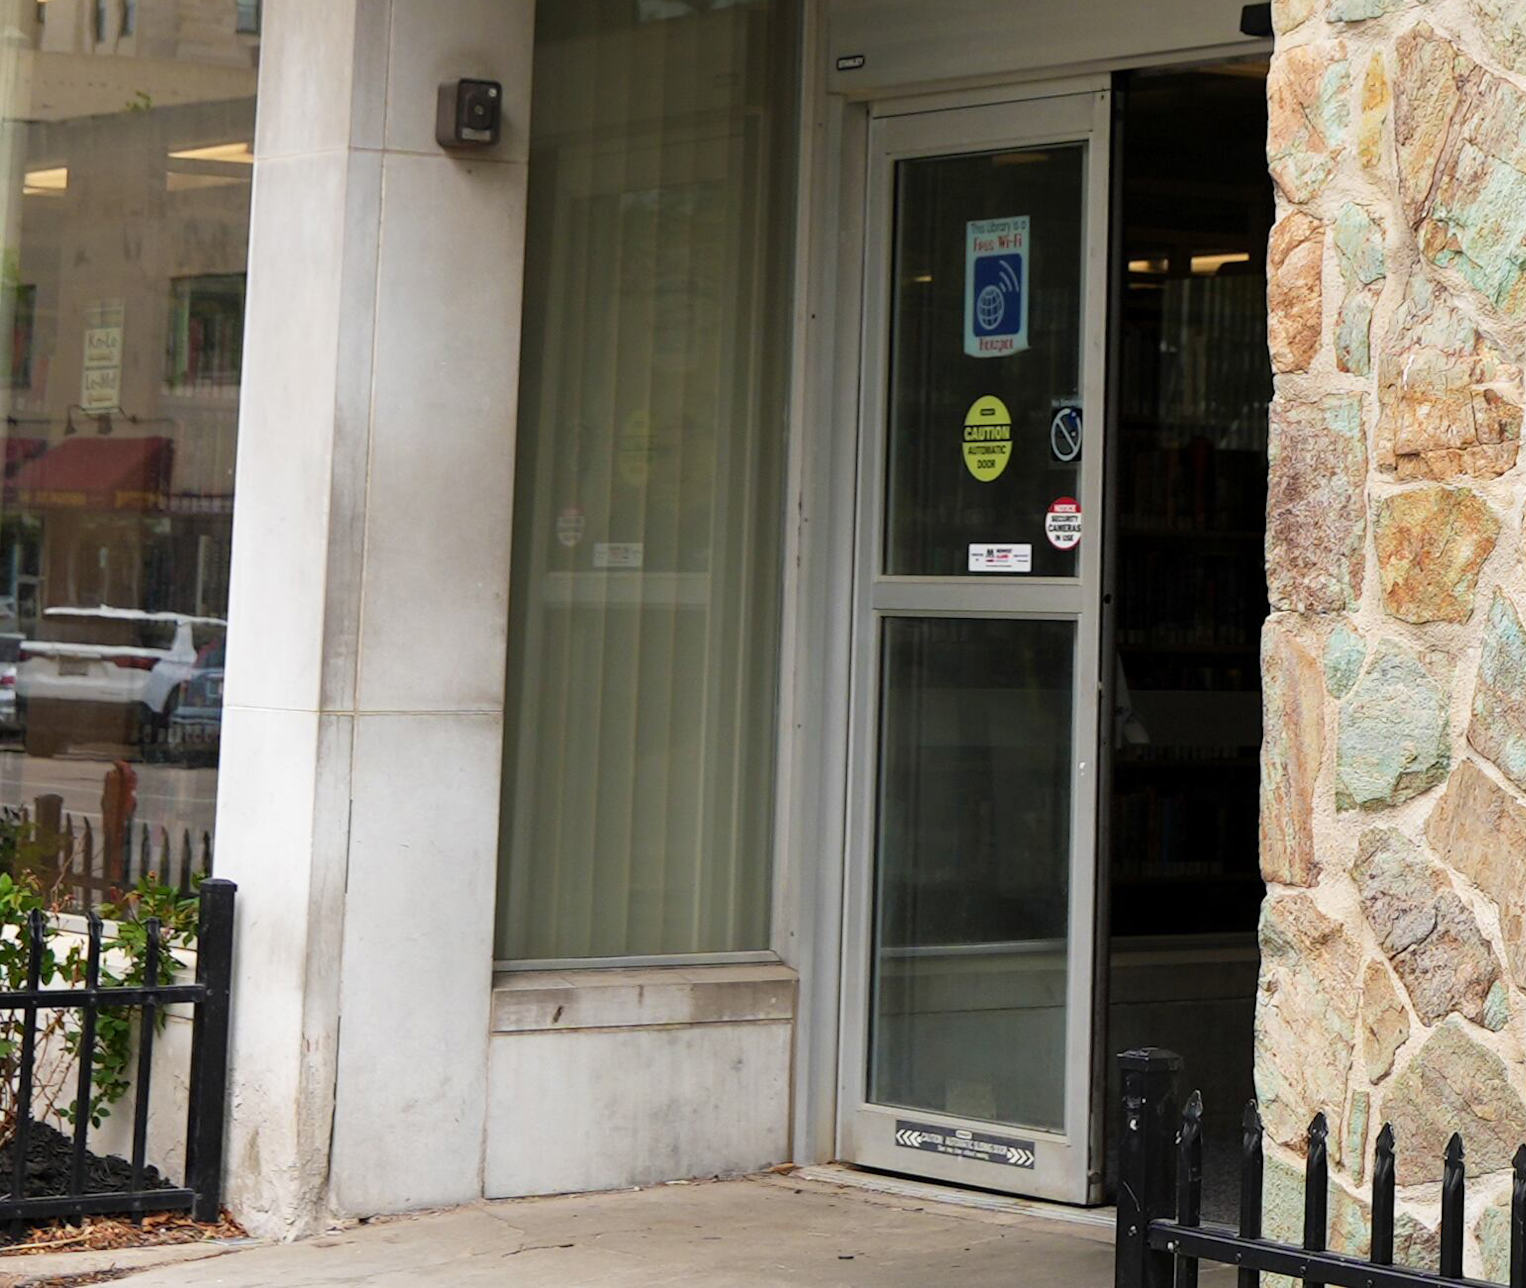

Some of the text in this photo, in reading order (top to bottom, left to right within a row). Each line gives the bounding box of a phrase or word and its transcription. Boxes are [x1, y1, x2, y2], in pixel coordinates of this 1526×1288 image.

[998, 233, 1022, 249] Wi-Fi
[963, 425, 1011, 441] CAUTION
[968, 444, 1007, 455] AUTOMATIC
[977, 459, 996, 469] DOOR
[1048, 523, 1082, 533] CAMERAS
